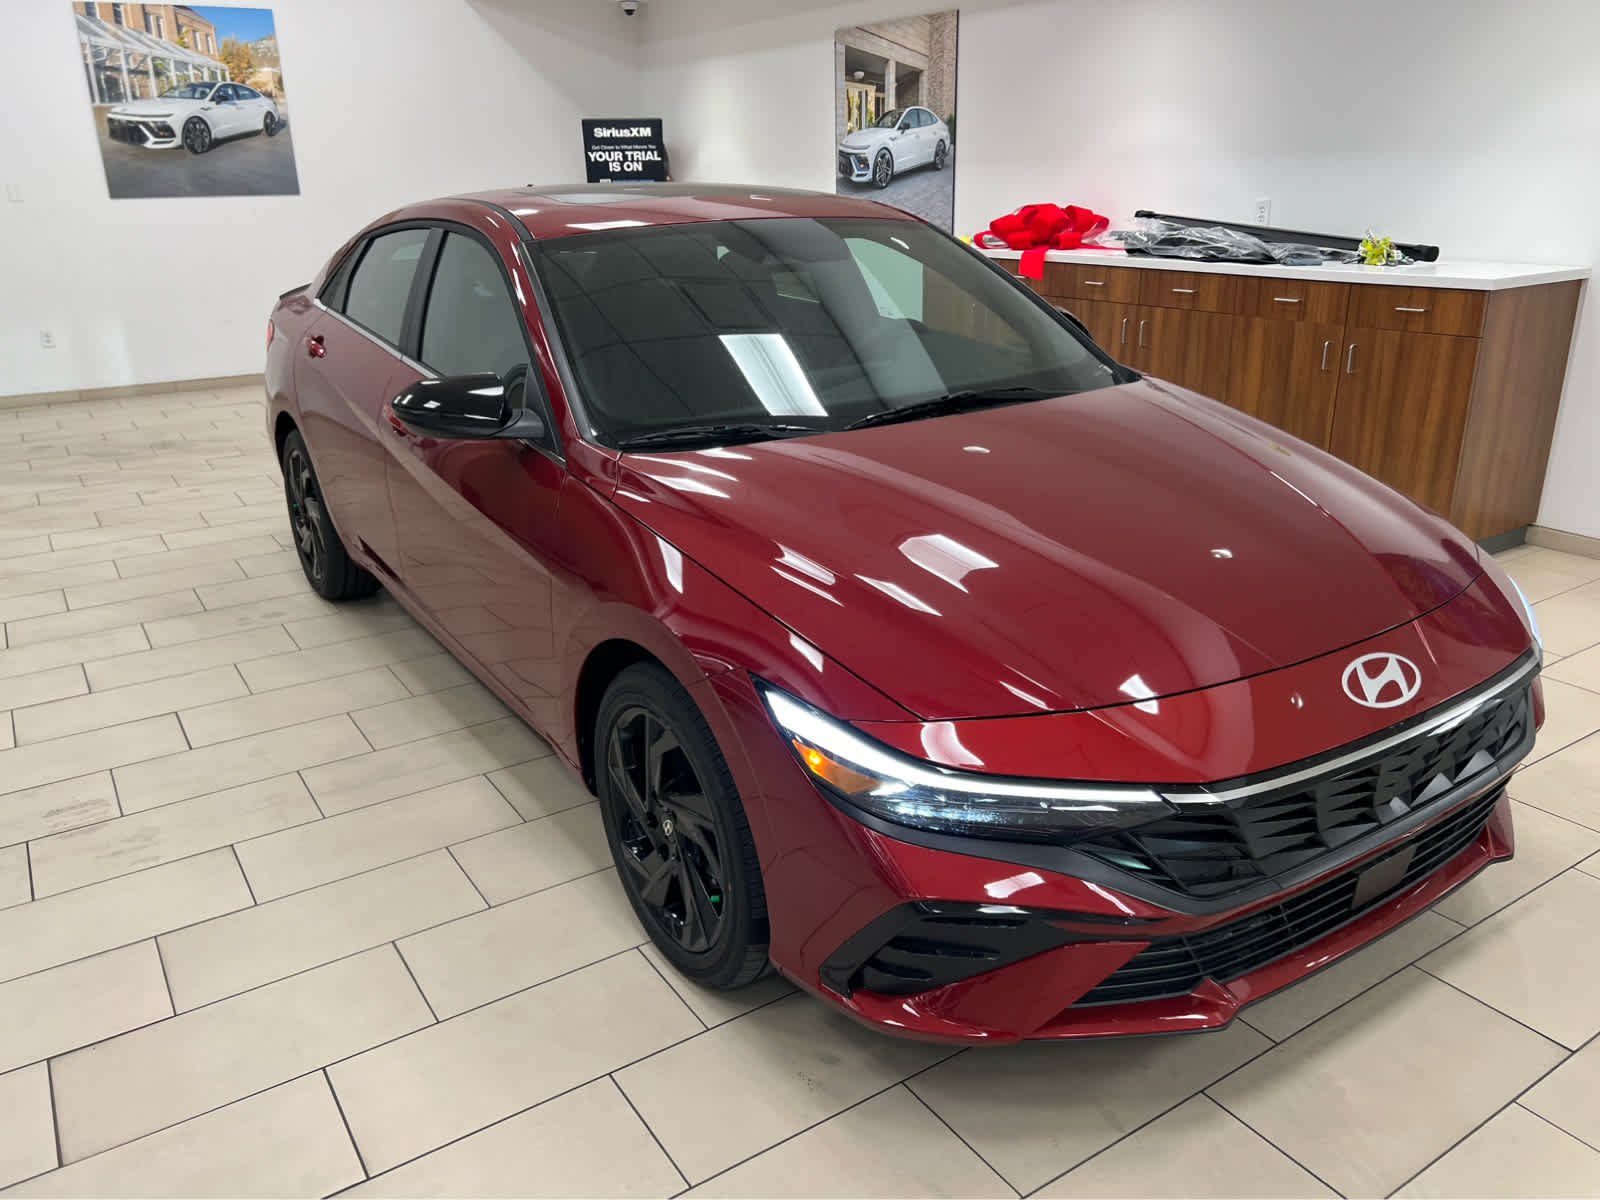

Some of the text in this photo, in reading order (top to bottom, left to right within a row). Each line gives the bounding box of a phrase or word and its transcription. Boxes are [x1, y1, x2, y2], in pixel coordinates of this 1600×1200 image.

[593, 127, 652, 138] SiriusXM
[587, 150, 662, 162] YOUR TRIAL
[609, 161, 643, 172] IS ON
